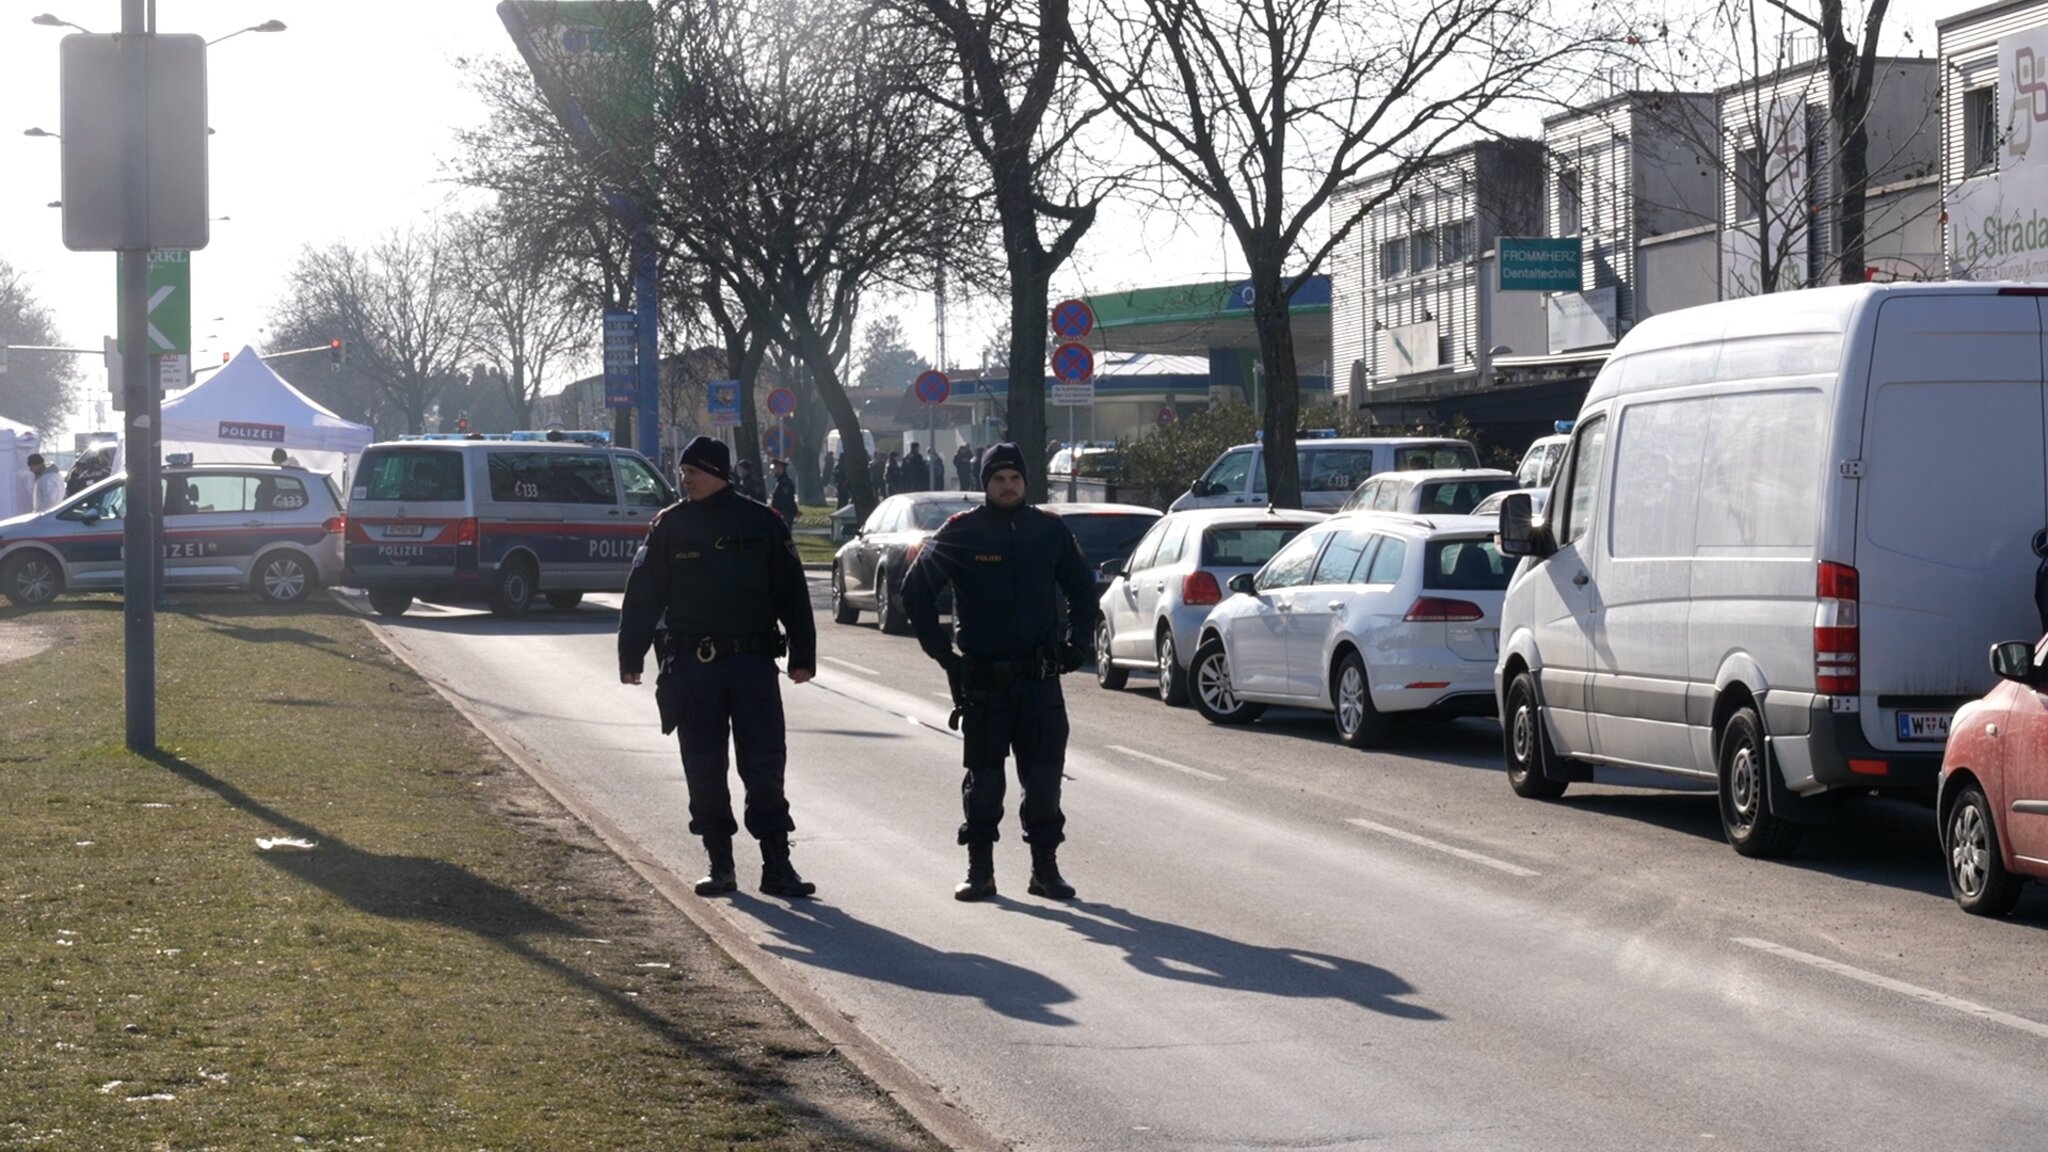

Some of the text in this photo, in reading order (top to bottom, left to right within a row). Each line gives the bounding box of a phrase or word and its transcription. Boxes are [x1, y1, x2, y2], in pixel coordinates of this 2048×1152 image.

[1953, 207, 2048, 264] La Strada
[1502, 250, 1577, 262] FROMMHERZ
[1502, 267, 1577, 279] Dentaltechnik
[221, 426, 273, 440] POLIZEI
[521, 483, 538, 498] 133
[282, 495, 303, 508] 133
[378, 545, 423, 556] POLIZEI
[975, 554, 1002, 562] POLIZEI
[1911, 716, 1924, 734] W
